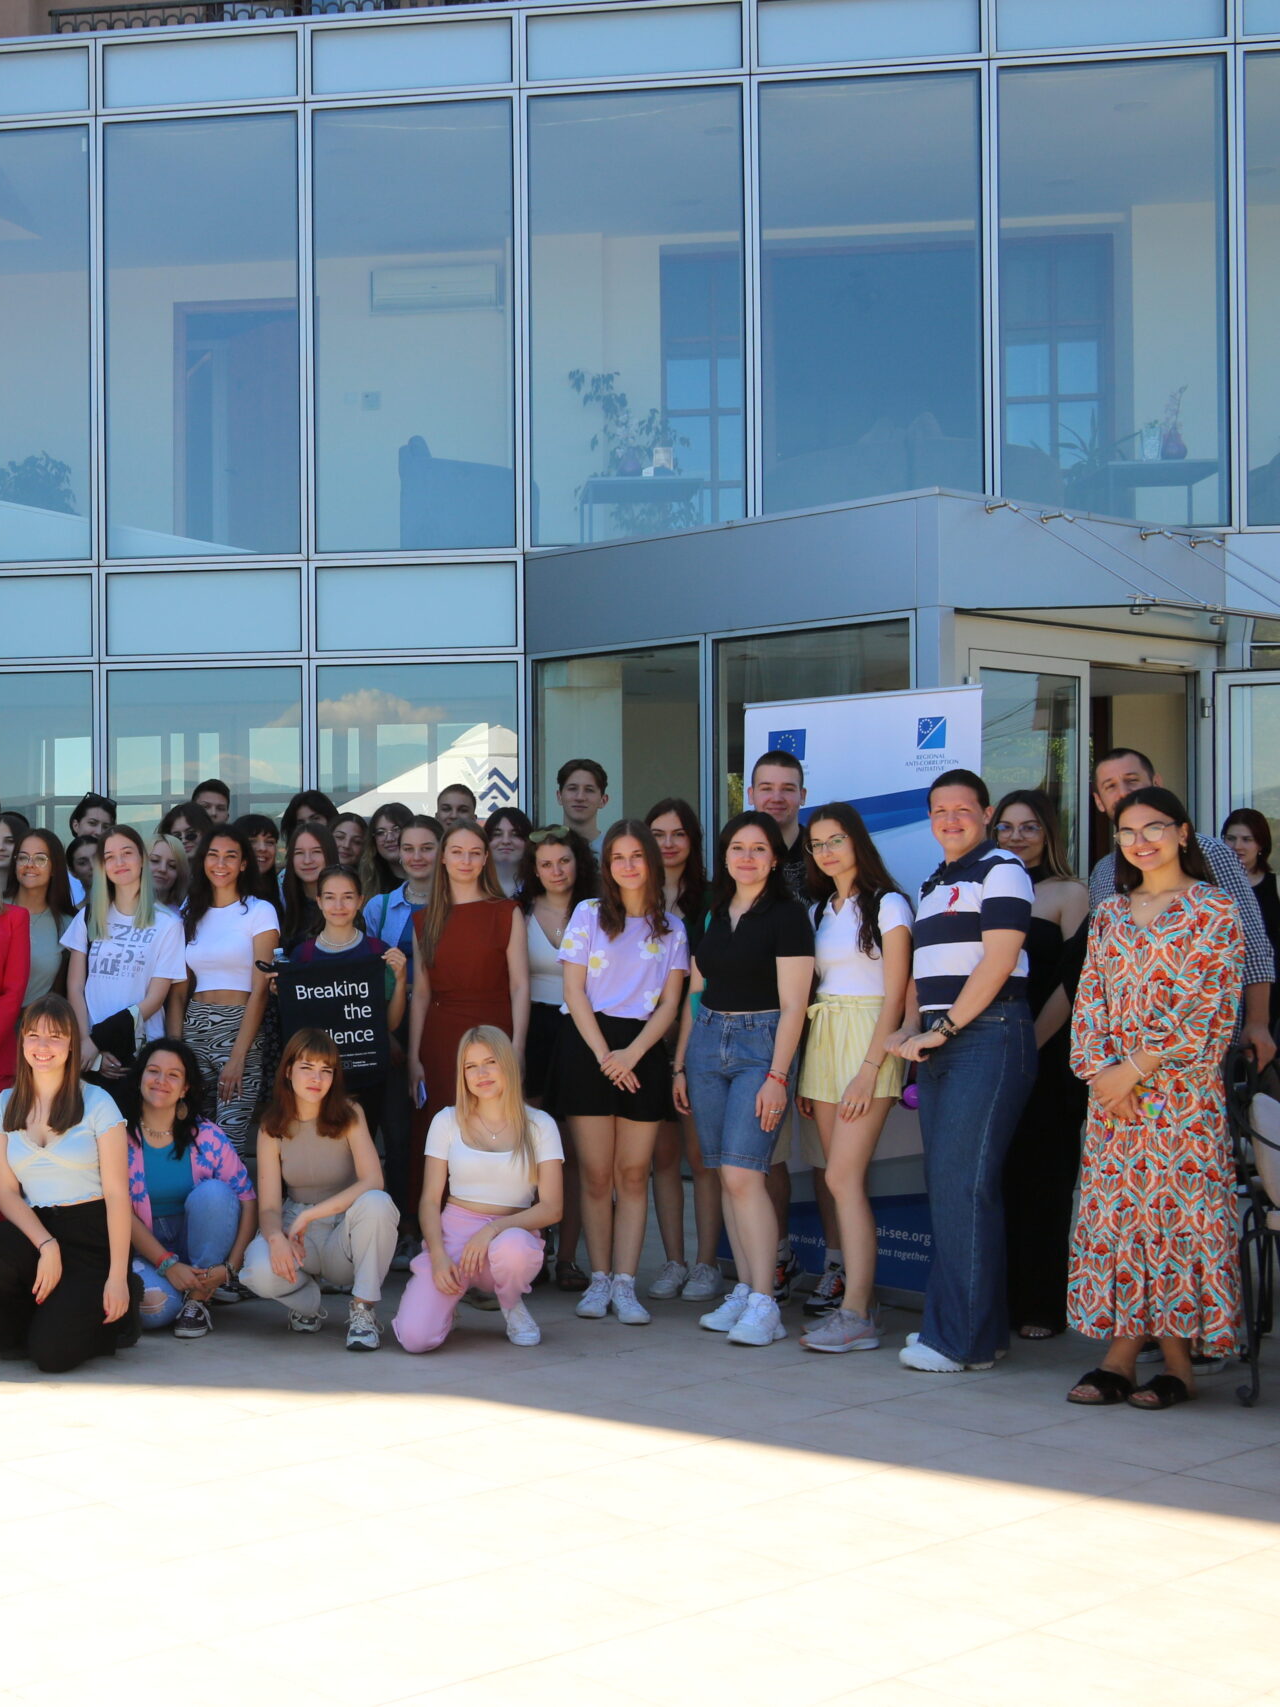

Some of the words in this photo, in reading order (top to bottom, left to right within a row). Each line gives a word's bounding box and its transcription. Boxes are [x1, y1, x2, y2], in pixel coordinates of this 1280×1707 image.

[295, 981, 369, 1000] Breaking
[343, 1003, 372, 1020] the
[876, 1225, 932, 1247] ai-see.org
[817, 1236, 826, 1248] fo
[877, 1246, 893, 1257] ons
[894, 1249, 931, 1263] together.
